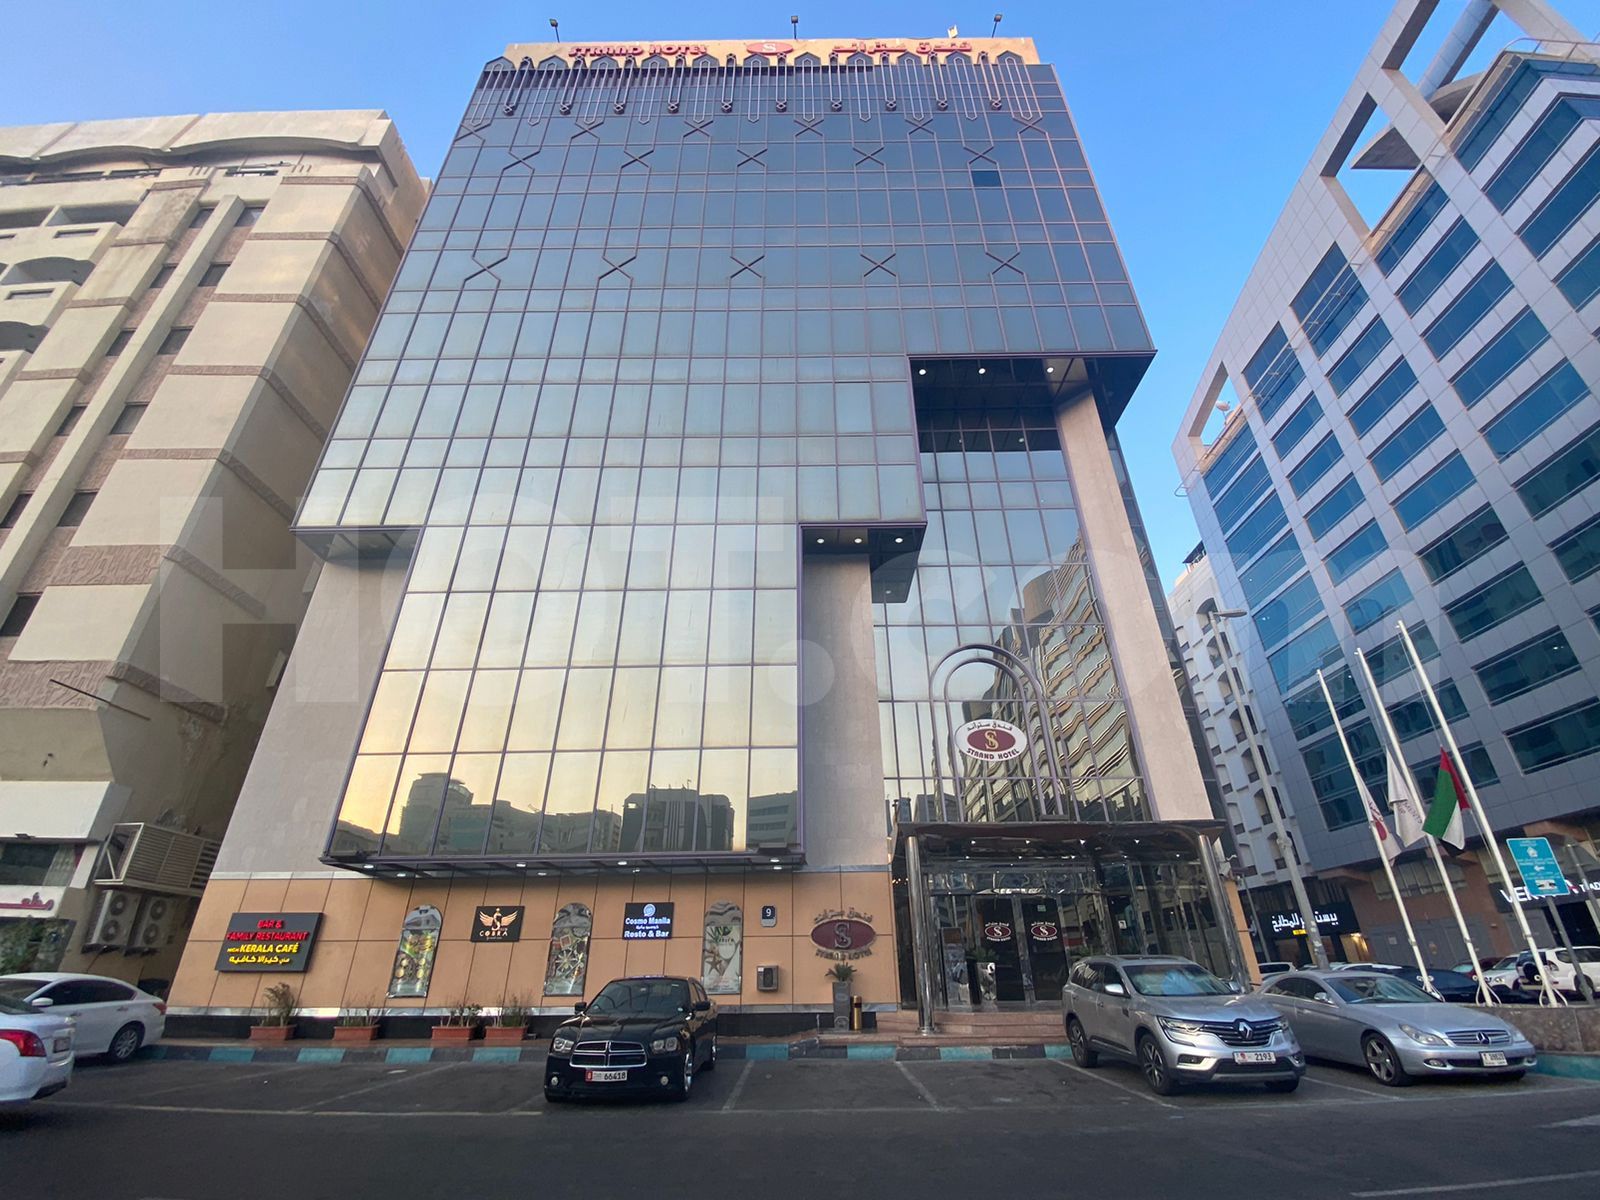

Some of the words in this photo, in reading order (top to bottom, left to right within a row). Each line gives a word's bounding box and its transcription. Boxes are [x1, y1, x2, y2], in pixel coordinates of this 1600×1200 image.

[568, 45, 643, 56] STRAND
[649, 44, 707, 55] HOTEL
[967, 748, 995, 760] STRAND
[997, 748, 1020, 760] HOTEL
[765, 908, 772, 917] 9
[257, 920, 274, 928] BAR
[275, 920, 282, 928] &
[625, 917, 647, 925] Cosmo
[226, 932, 254, 940] FAMILY
[256, 932, 308, 940] RESTAURANT
[624, 930, 646, 938] Resto
[647, 930, 655, 938] &
[655, 930, 670, 938] Bar
[240, 944, 274, 953] KERALA
[275, 942, 300, 953] CAFÉ
[1255, 1052, 1272, 1061] 2193
